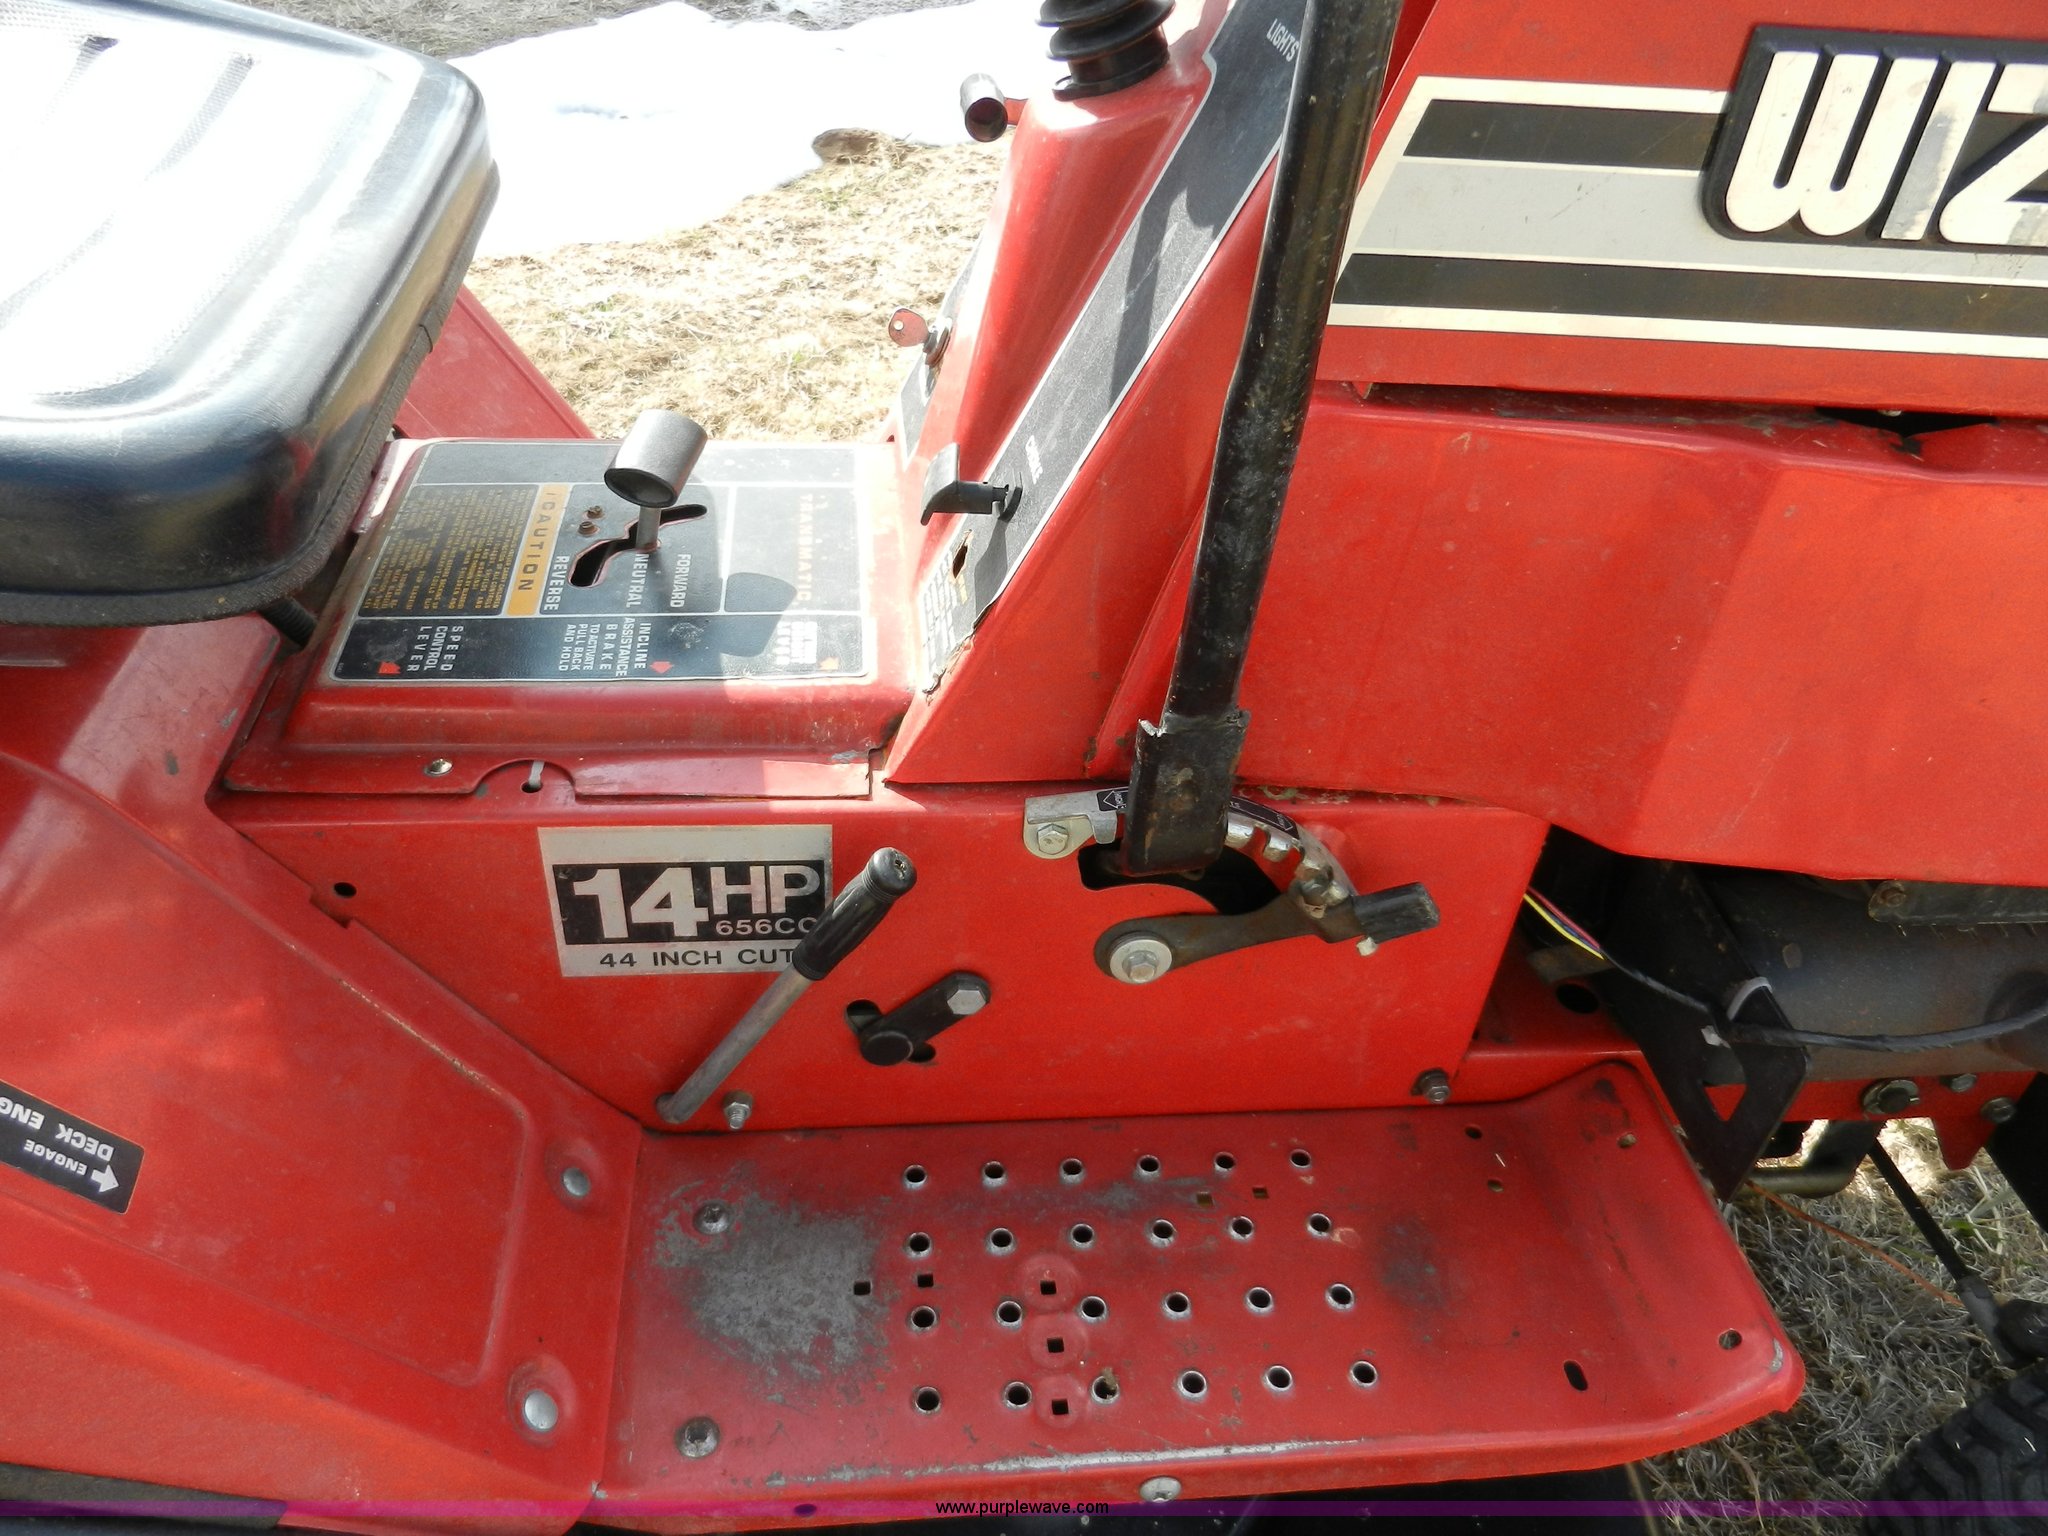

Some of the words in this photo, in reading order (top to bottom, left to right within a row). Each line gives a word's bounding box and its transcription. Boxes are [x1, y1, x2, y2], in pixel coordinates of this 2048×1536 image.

[1266, 18, 1300, 62] LIGHTS
[518, 501, 556, 591] CAUTION
[543, 555, 570, 611] REVERSE
[626, 553, 650, 608] NEUTRAL
[669, 554, 691, 608] FORWARD
[406, 625, 433, 672] LEVER
[423, 625, 449, 671] CONTROL
[440, 625, 464, 671] SPEED
[564, 624, 577, 643] AND
[575, 623, 588, 645] PULL
[582, 634, 599, 671] ACTIVATE
[599, 623, 619, 670] BRAKE
[615, 617, 636, 677] ASSISTANCE
[634, 622, 652, 669] INCLINE
[558, 646, 573, 671] HOLD
[570, 645, 585, 671] BACK
[715, 916, 817, 936] 656CC
[599, 952, 638, 968] 44
[652, 949, 723, 967] INCH
[23, 1139, 88, 1176] ENGAGE
[55, 1123, 115, 1162] DECK
